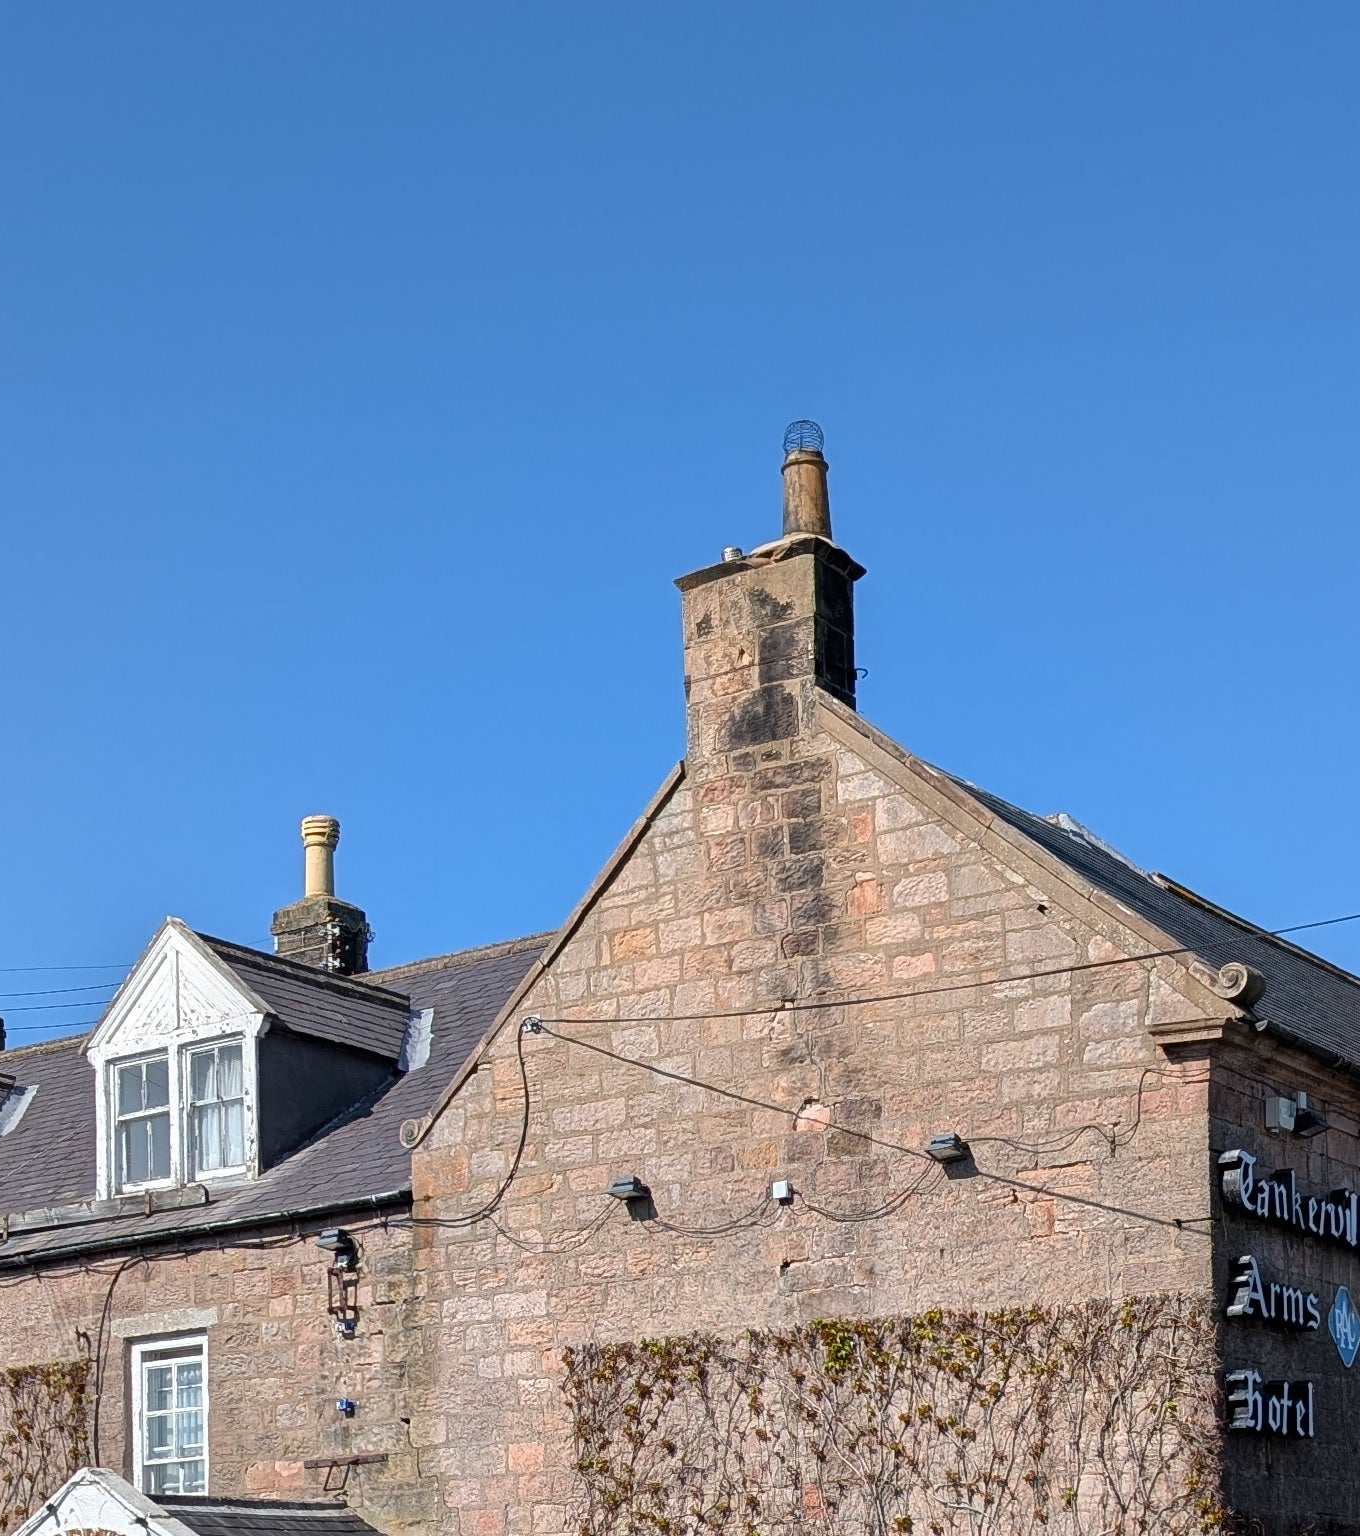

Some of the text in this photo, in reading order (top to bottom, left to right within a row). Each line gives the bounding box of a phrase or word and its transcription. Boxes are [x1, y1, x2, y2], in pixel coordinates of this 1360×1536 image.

[1227, 1255, 1321, 1331] Arms
[1334, 1300, 1356, 1350] RAC
[1226, 1367, 1315, 1437] Hotel
